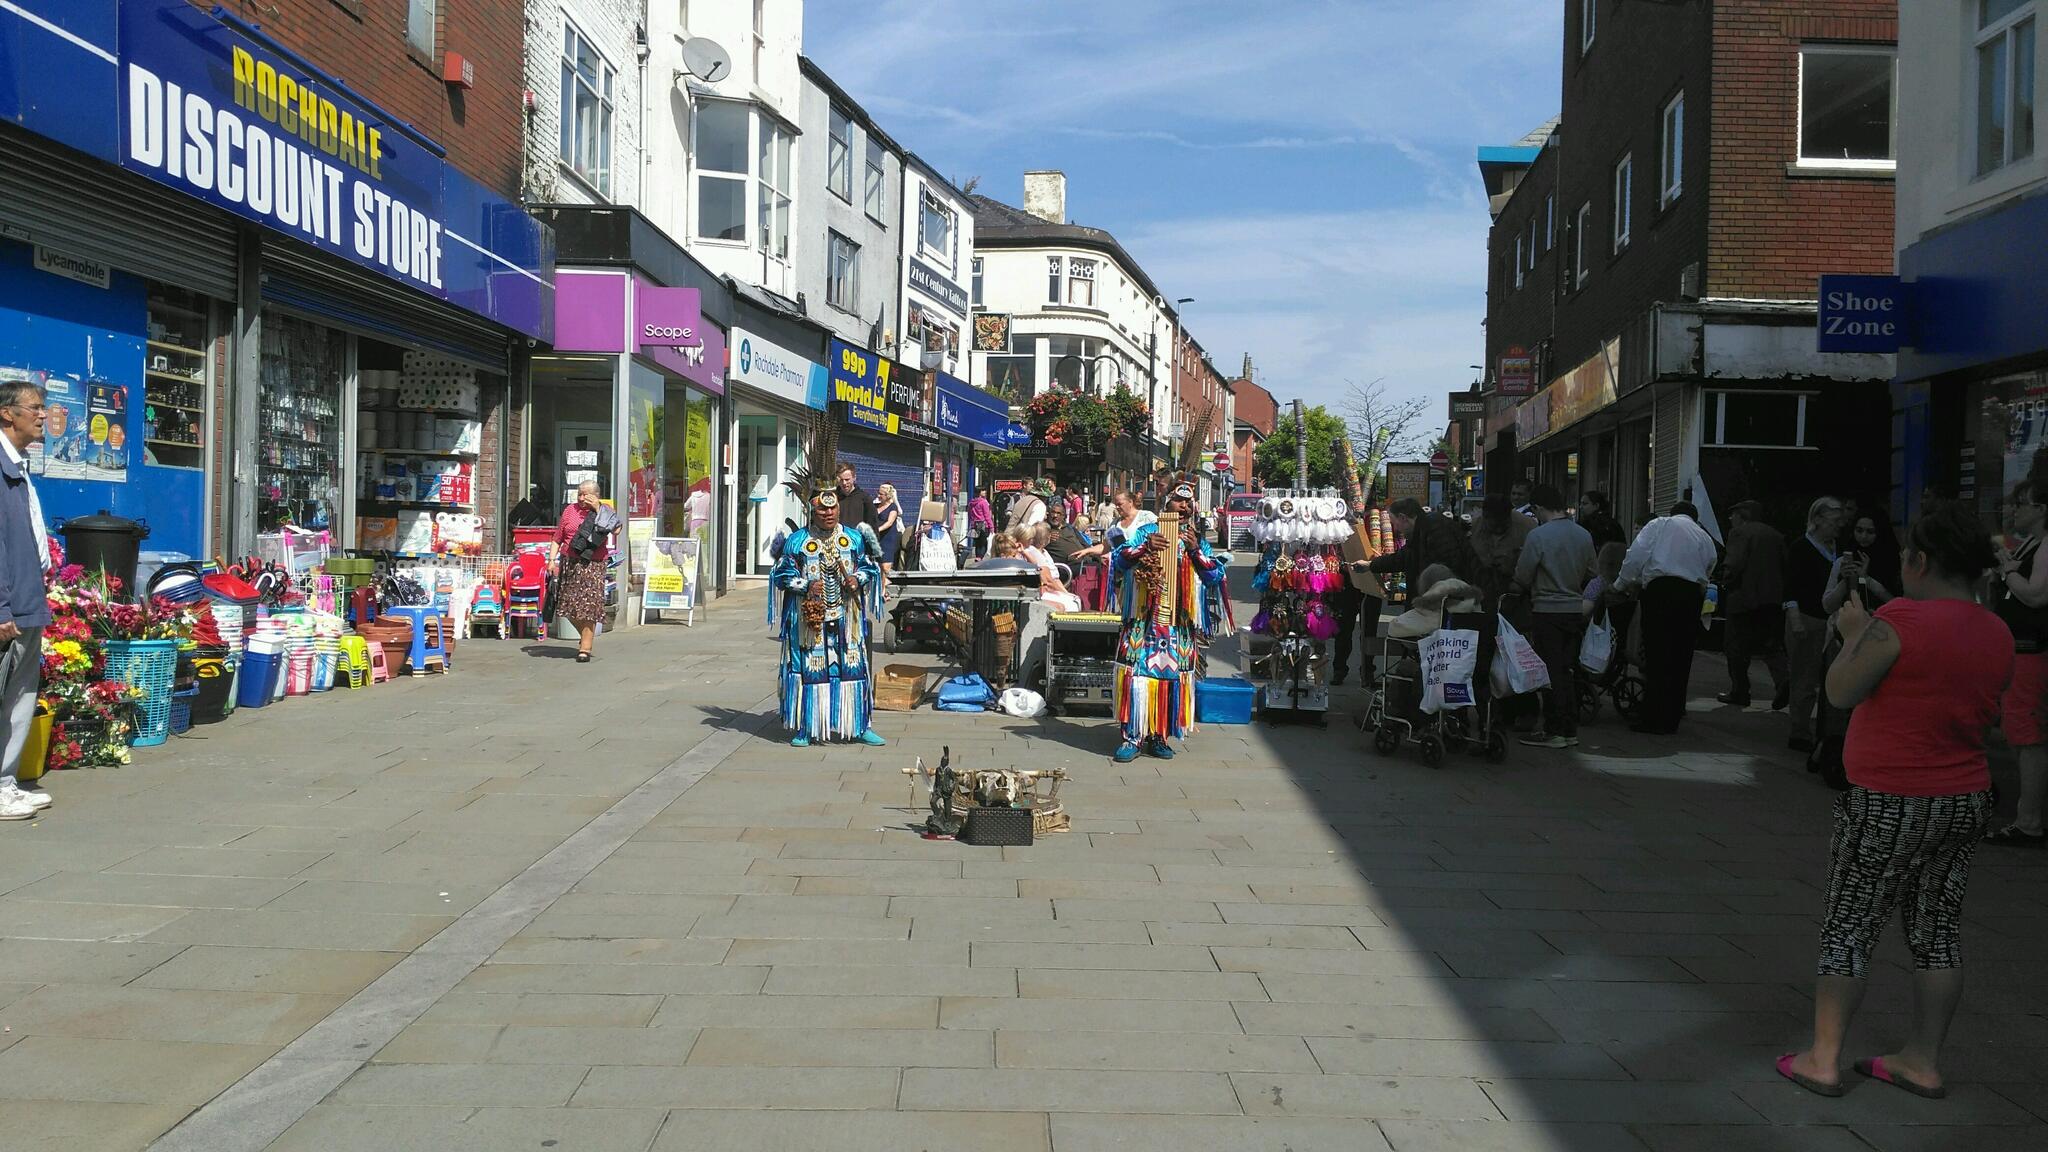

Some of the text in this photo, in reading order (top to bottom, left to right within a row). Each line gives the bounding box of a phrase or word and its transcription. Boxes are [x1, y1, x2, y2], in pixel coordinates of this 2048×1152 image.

[233, 44, 382, 181] ROCHDALE
[129, 62, 443, 289] DISCOUNT STORE
[40, 247, 105, 280] Lycamobile
[911, 265, 967, 310] 21st Century Tattoos
[1828, 291, 1894, 311] Shoe
[645, 324, 692, 340] Scope
[1825, 316, 1896, 336] Zone
[754, 351, 806, 392] Rochdale Pharmacy
[842, 348, 867, 378] 99p
[835, 378, 872, 408] World
[875, 375, 885, 398] &
[890, 381, 920, 409] PERFUME
[853, 405, 879, 427] Everything
